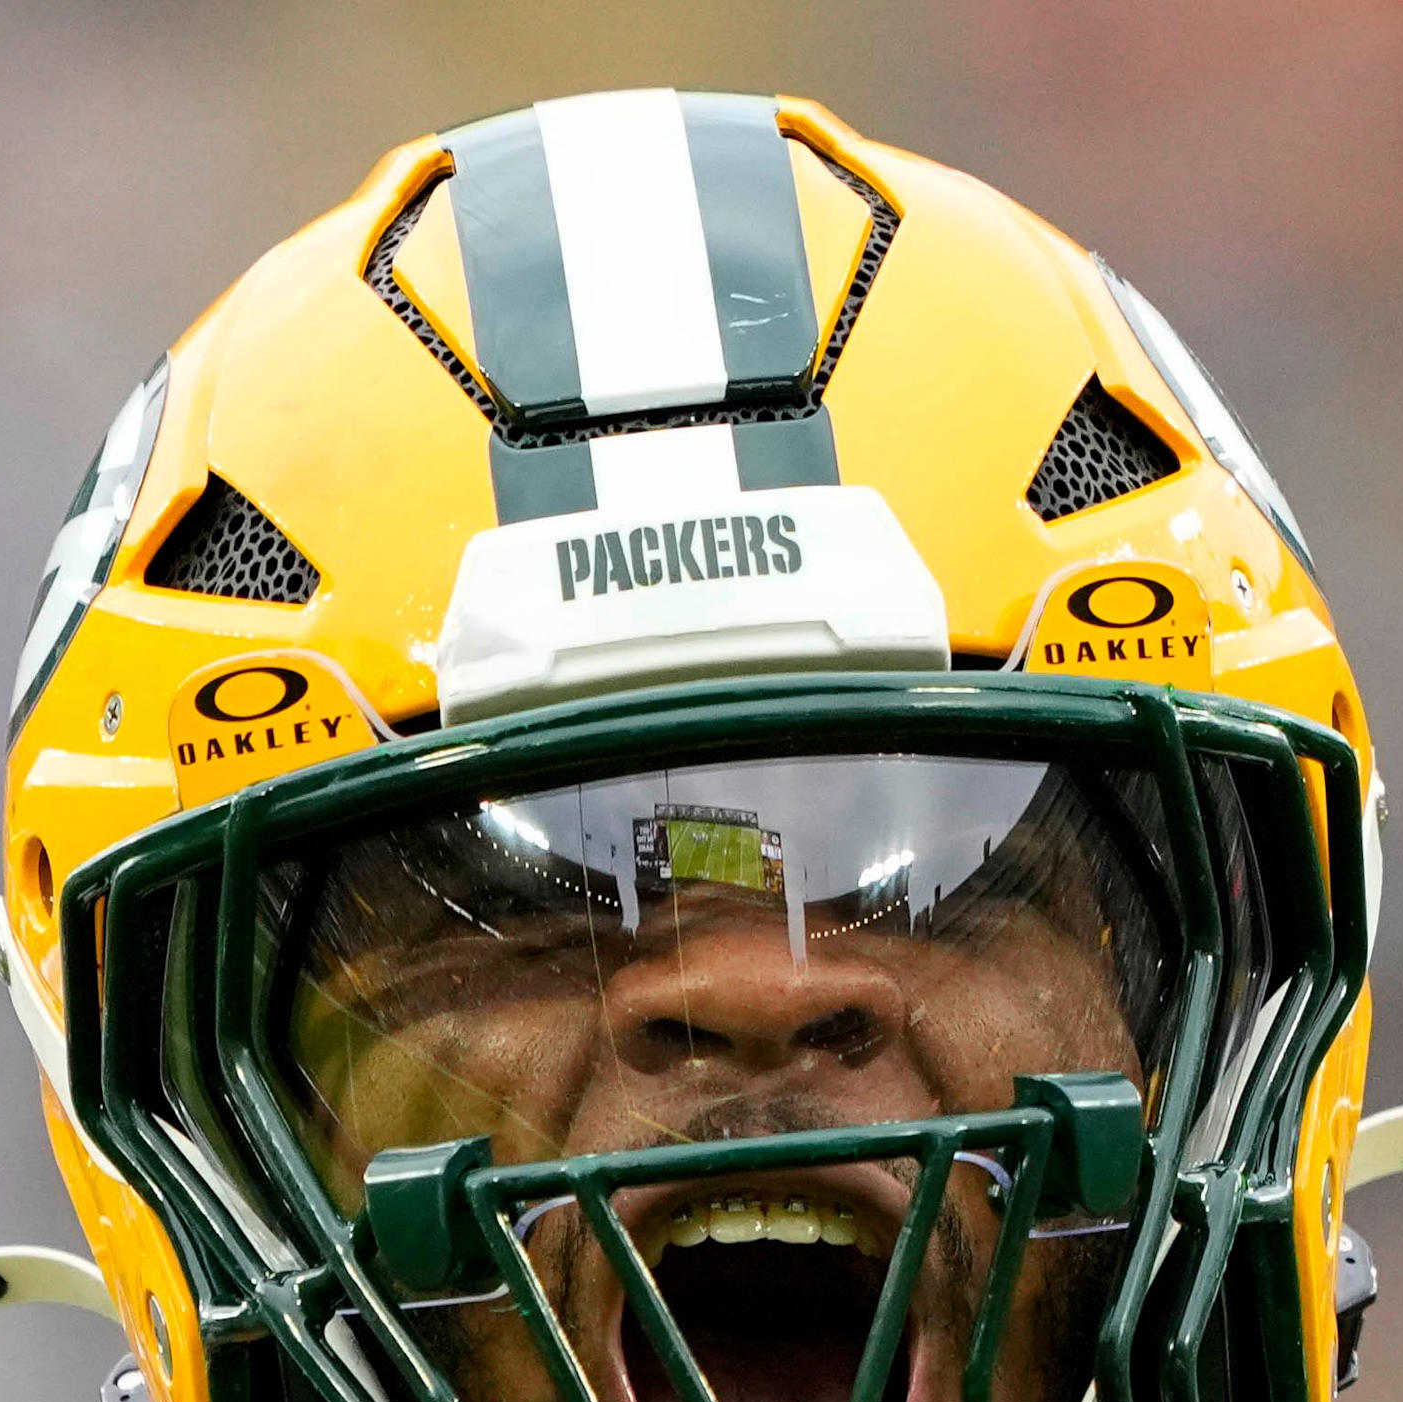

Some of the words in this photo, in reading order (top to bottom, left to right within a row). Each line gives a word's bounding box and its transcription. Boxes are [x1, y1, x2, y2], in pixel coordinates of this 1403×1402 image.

[555, 514, 802, 602] PACKERS
[1044, 634, 1198, 665] OAKLEY
[177, 715, 342, 766] OAKLEY
